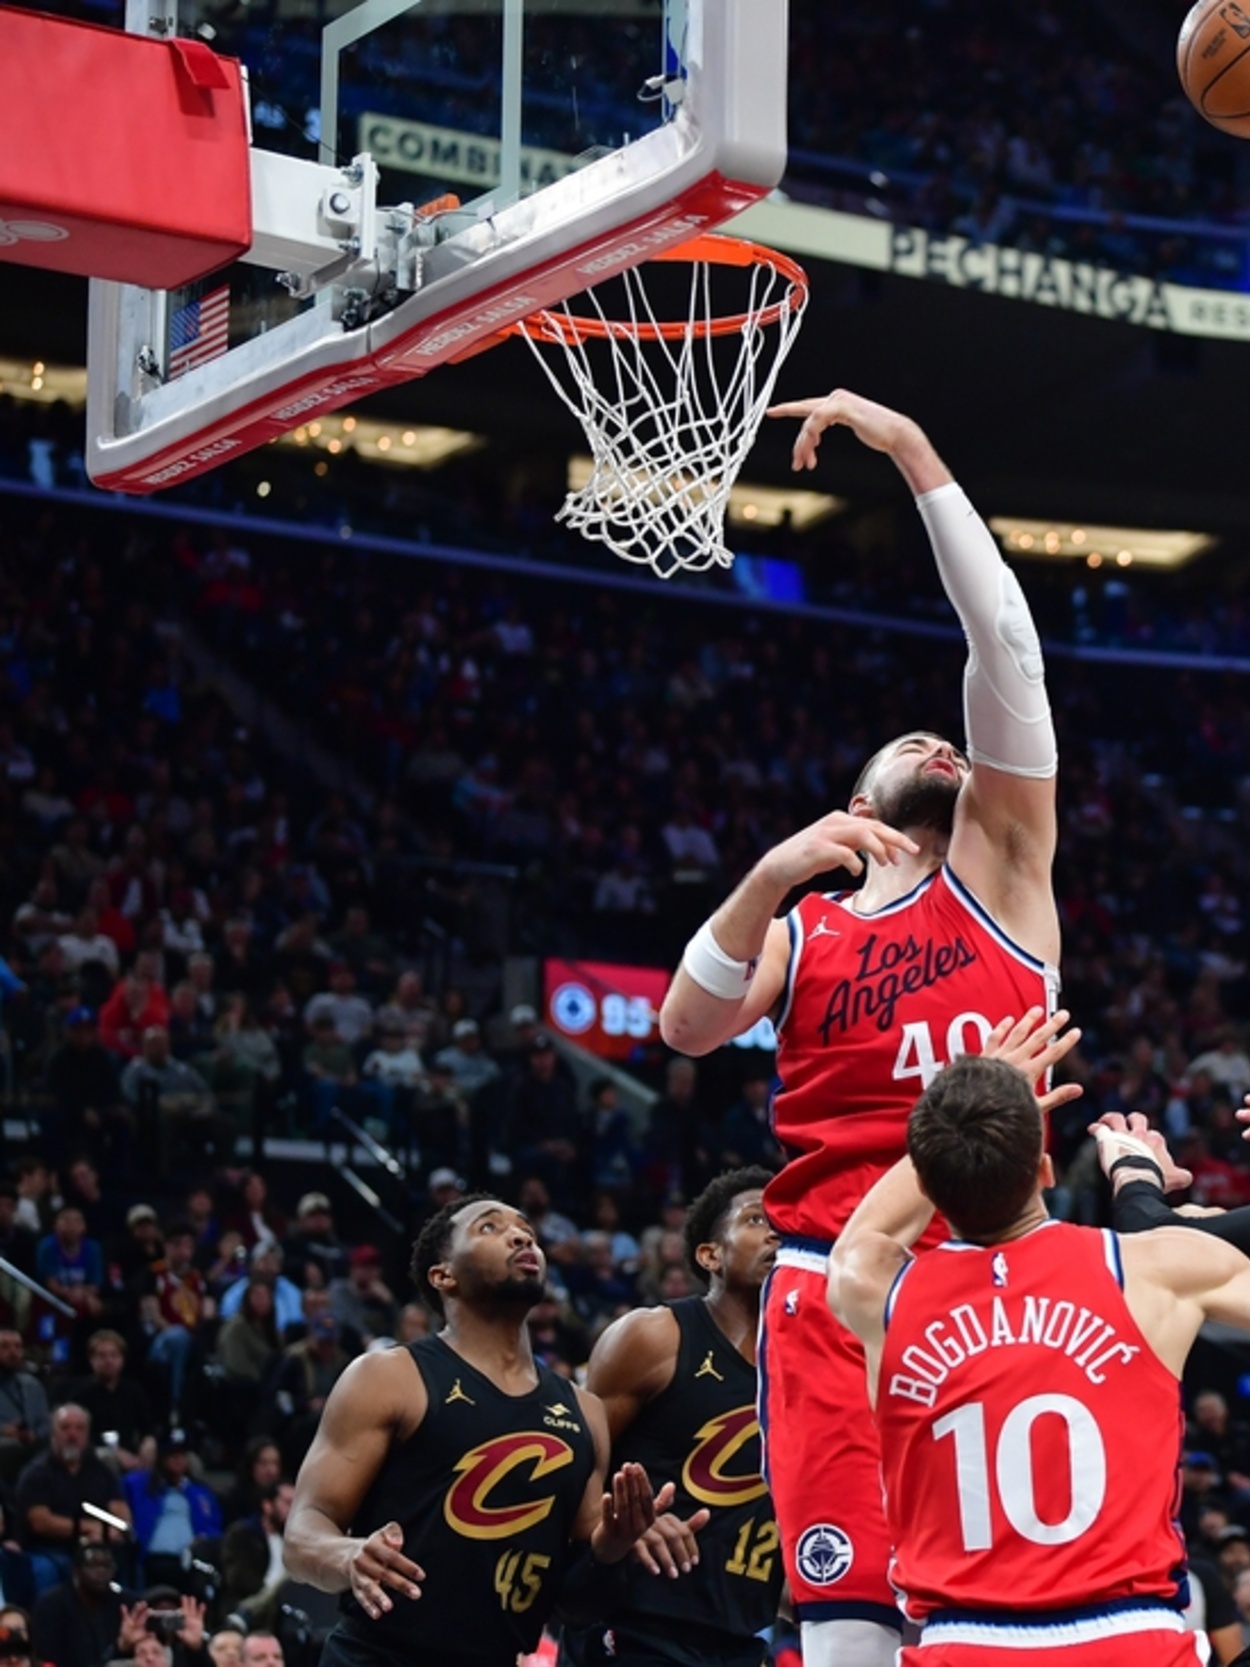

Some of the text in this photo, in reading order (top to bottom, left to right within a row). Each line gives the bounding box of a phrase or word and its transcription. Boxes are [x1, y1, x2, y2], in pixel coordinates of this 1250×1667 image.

[368, 124, 580, 187] COMBIA
[891, 225, 1172, 331] PECHANGA
[818, 936, 977, 1046] Angeles
[855, 933, 921, 982] Los
[892, 1011, 996, 1091] 40
[888, 1295, 1140, 1408] BOGDANOVIĆ
[444, 1430, 574, 1540] C
[931, 1393, 1107, 1552] 10
[494, 1548, 551, 1613] 45
[725, 1516, 778, 1583] 12
